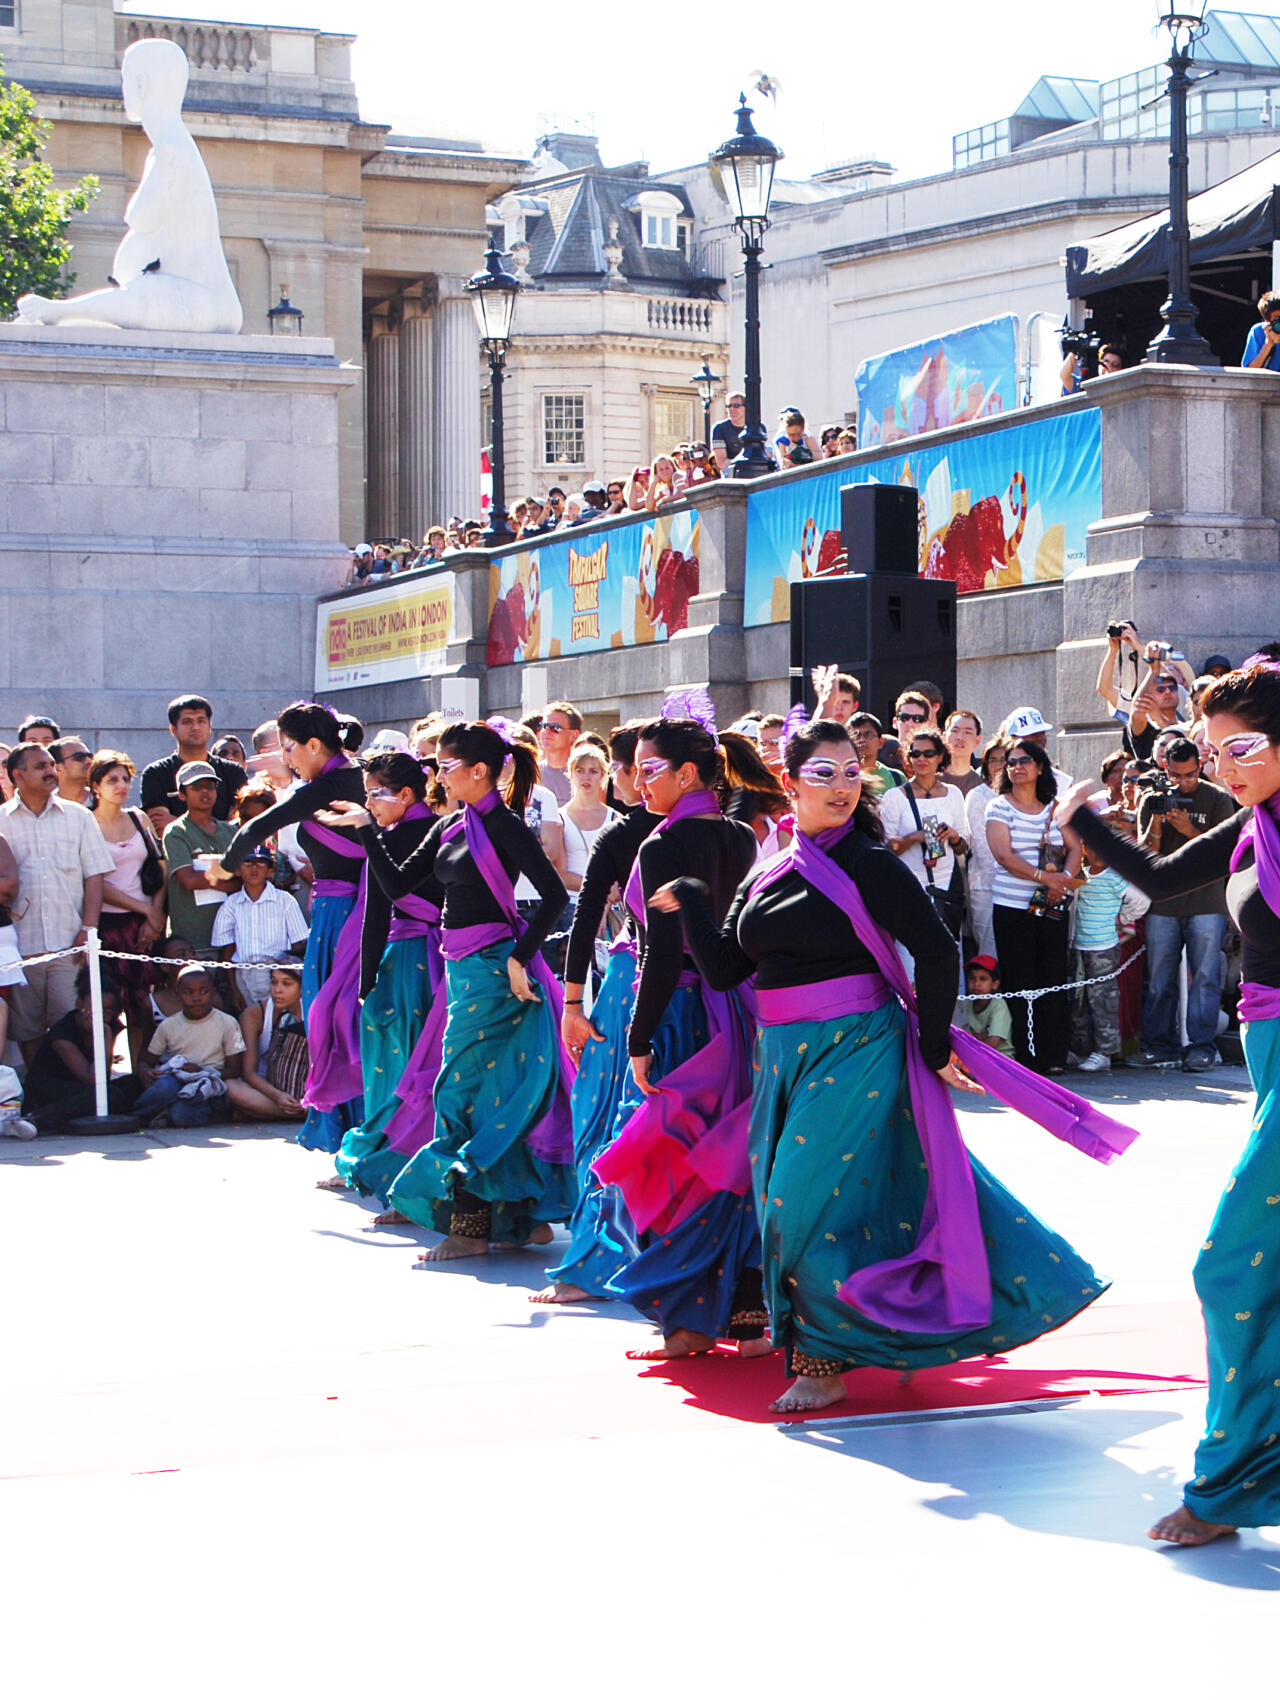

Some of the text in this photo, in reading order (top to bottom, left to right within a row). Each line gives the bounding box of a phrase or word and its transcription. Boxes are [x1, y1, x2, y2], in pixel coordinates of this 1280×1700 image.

[568, 540, 608, 586] TRAFALGAR
[574, 582, 599, 612] SQUARE
[353, 617, 377, 641] FESTIVAL
[379, 614, 387, 636] OF
[388, 611, 407, 634] INDIA
[409, 607, 418, 631] IN
[419, 600, 447, 627] LONDON
[571, 612, 599, 642] FESTIVAL
[443, 707, 464, 718] Toilets
